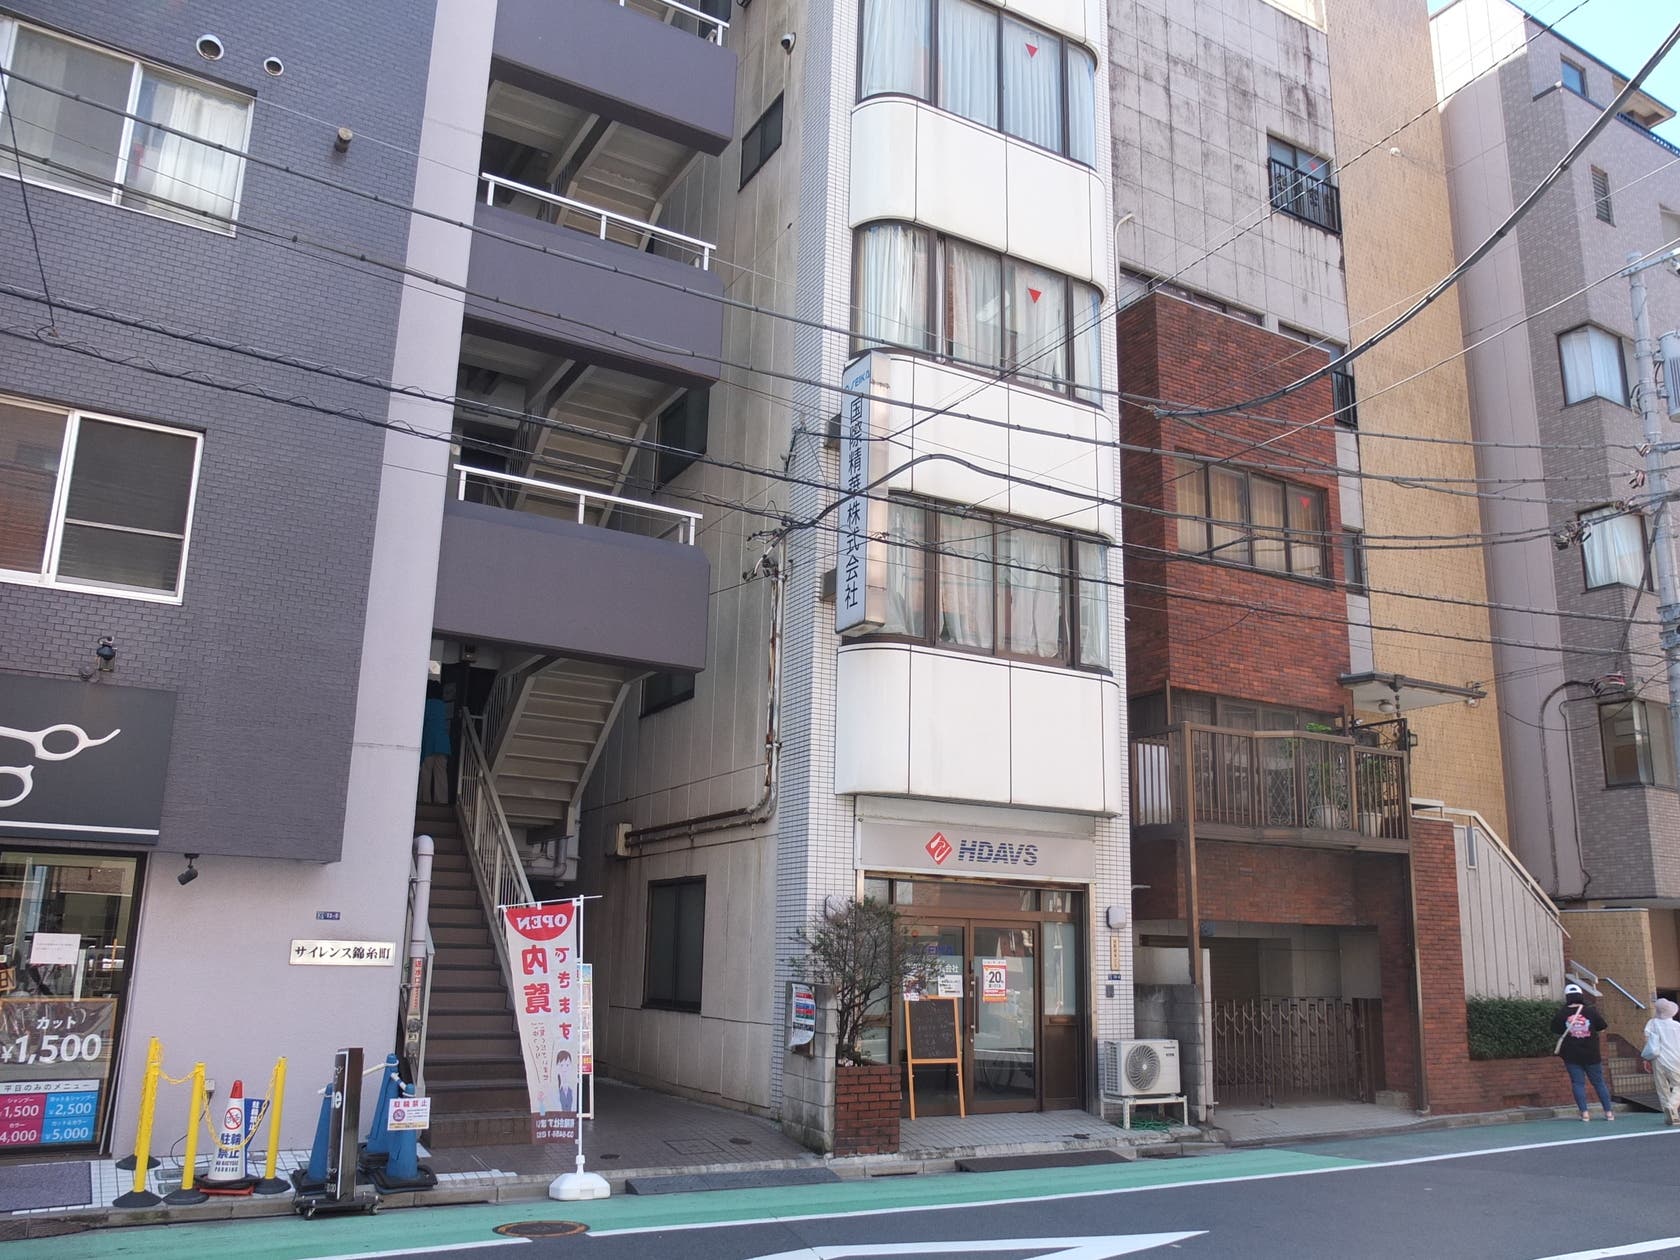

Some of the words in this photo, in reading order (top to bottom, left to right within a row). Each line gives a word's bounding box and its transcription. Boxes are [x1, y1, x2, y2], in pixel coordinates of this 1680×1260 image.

[958, 839, 1038, 866] HDAVS
[295, 946, 391, 960] サイレンス錦糸町
[36, 1016, 77, 1030] カット
[1, 1033, 101, 1064] ¥1,500
[4, 1082, 91, 1092] 平日のみのメニュー
[221, 1133, 241, 1145] 駐輪
